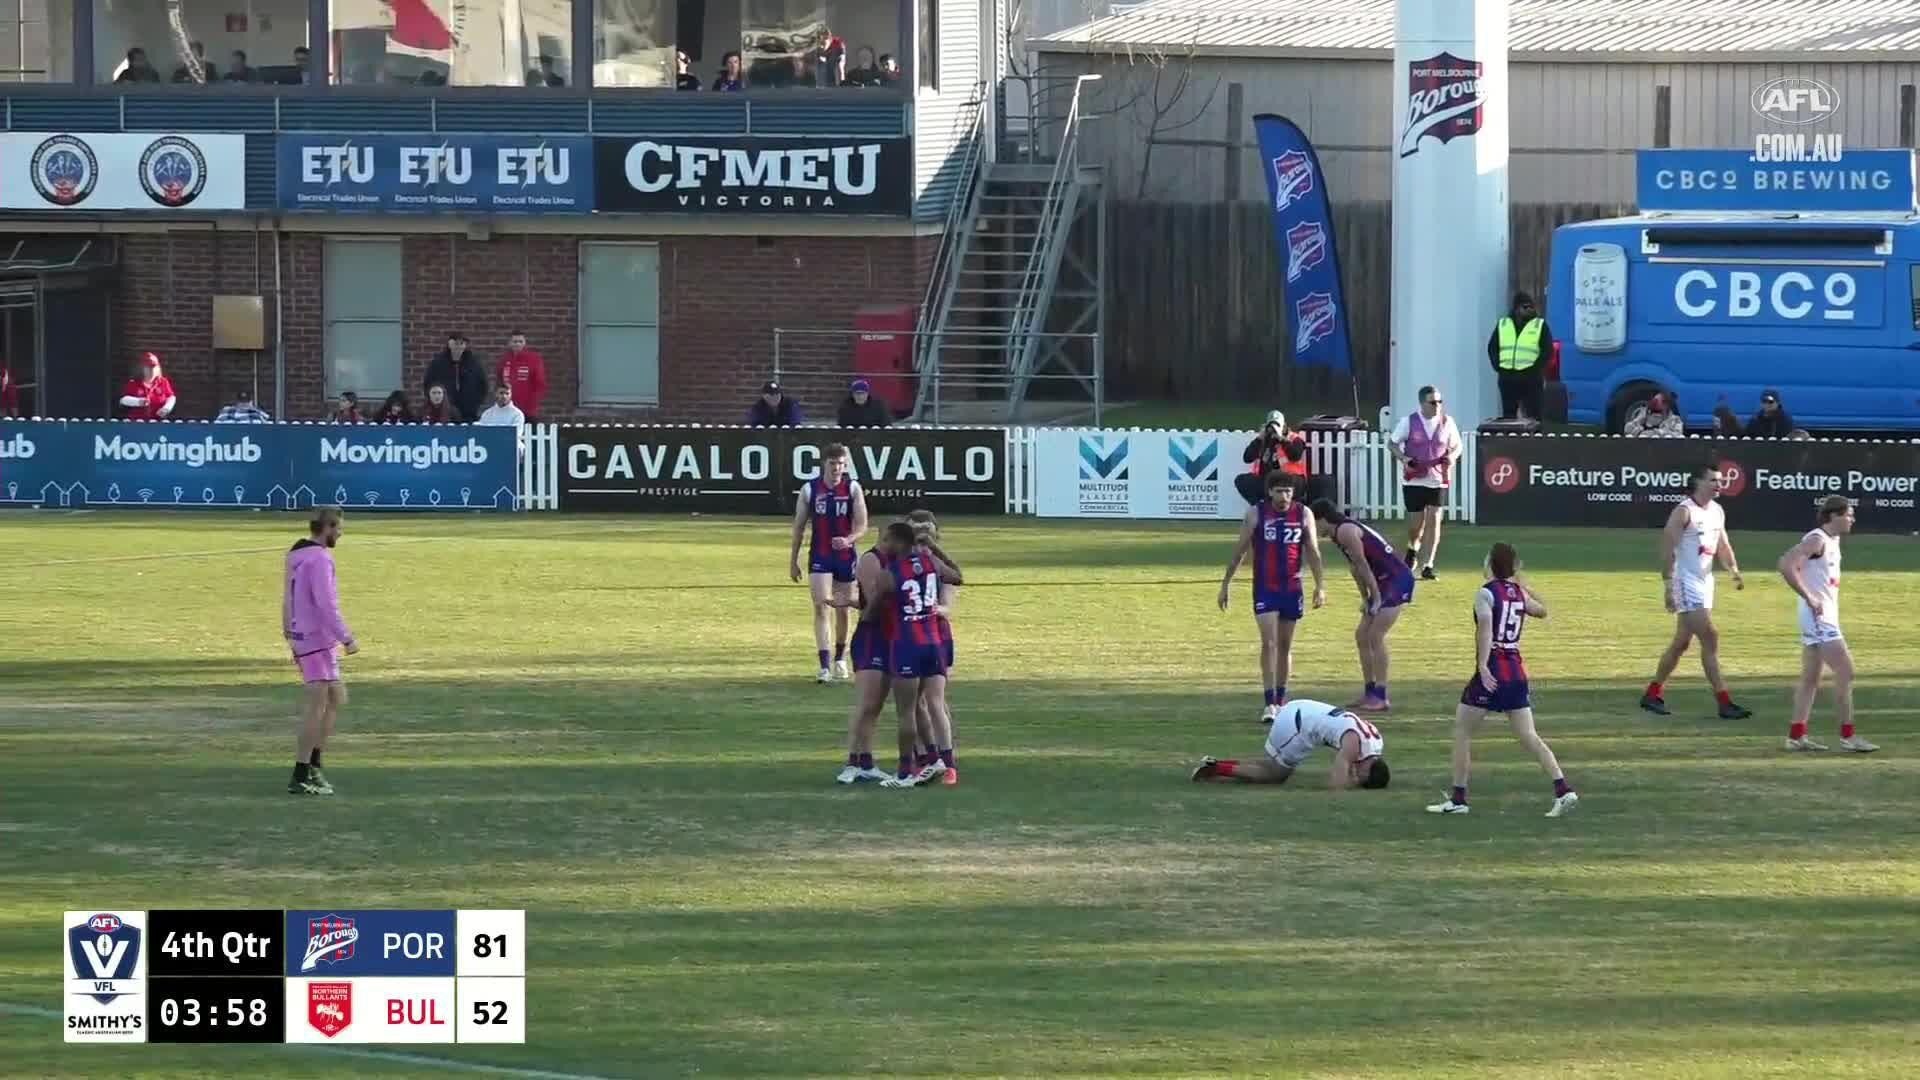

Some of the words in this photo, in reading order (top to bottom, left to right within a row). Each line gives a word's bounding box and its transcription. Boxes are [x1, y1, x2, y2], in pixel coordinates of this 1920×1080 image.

[302, 140, 374, 187] ETU
[399, 140, 472, 187] ETU
[497, 141, 570, 188] ETU
[625, 141, 882, 195] CFMEU
[1754, 170, 1892, 190] BREWING
[679, 195, 835, 206] VICTORIA
[94, 433, 262, 467] Movinghub
[320, 436, 488, 470] Movinghub
[567, 443, 770, 480] CAVALO
[1529, 463, 1616, 487] Feature
[1621, 466, 1692, 489] Power
[1755, 468, 1842, 491] Feature
[1848, 469, 1918, 492] Power
[640, 487, 699, 496] PRESTIGE
[864, 488, 922, 497] PRESTIGE
[1079, 483, 1129, 492] MULTITUDE
[1168, 484, 1219, 493] MULTITUDE
[1587, 492, 1606, 501] LOW
[1608, 493, 1633, 502] CODE
[1648, 494, 1662, 502] NO
[835, 501, 848, 517] 14
[1875, 498, 1889, 507] NO
[1891, 499, 1915, 508] CODE
[1283, 528, 1302, 544] 22
[901, 573, 938, 614] 34
[1498, 600, 1524, 641] 15
